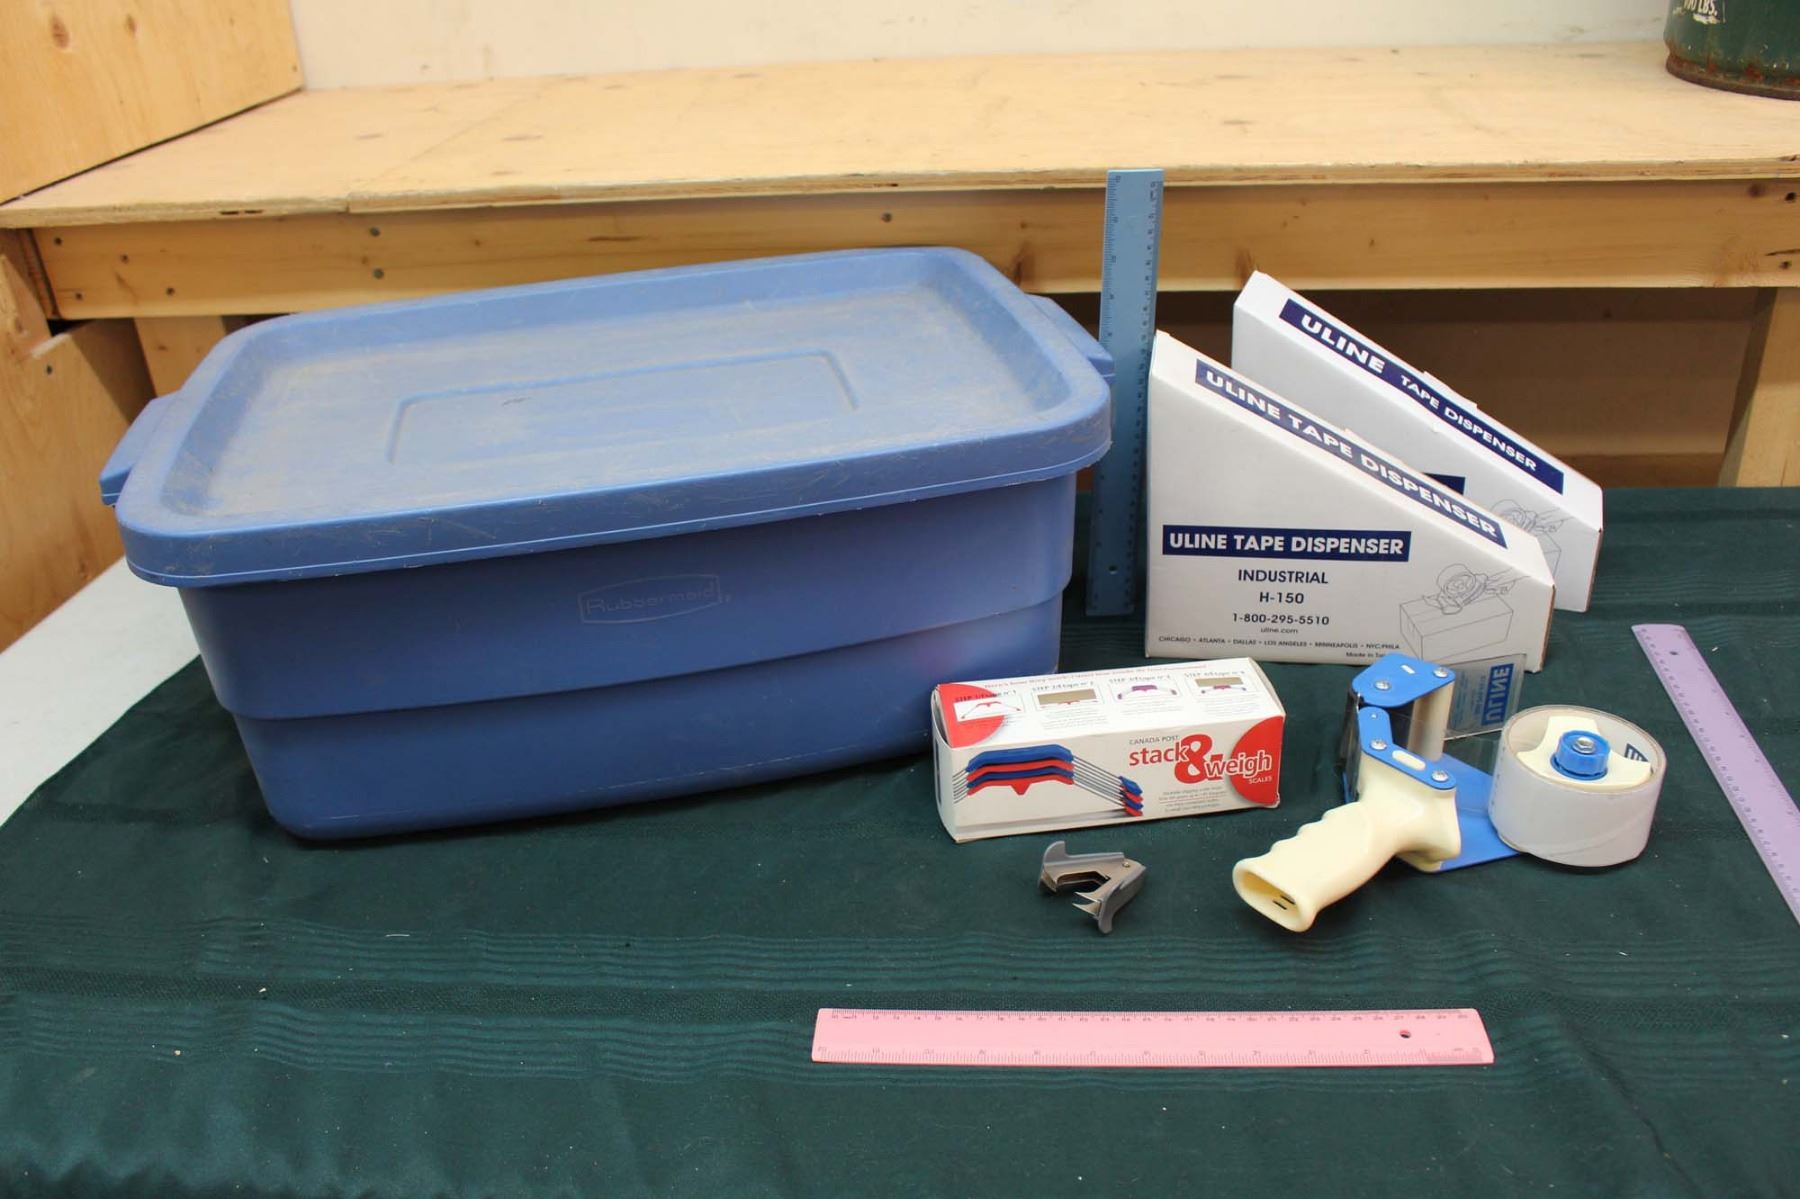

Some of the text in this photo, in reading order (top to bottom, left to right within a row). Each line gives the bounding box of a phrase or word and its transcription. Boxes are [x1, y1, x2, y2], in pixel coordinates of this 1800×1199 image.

[1301, 314, 1537, 472] ULINE TAPE DISPENSER
[1206, 371, 1498, 538] ULINE TAPE DISPENSER
[1169, 532, 1404, 555] ULINE TAPE DISPENSER
[1238, 569, 1329, 584] INDUSTRIAL
[1259, 592, 1305, 604] H-150
[1232, 613, 1330, 626] 1-800-295-5510
[1158, 635, 1191, 643] CHICAGO
[1314, 641, 1359, 649] MINNEAPOLIS
[1129, 734, 1180, 745] CANADA POST
[1129, 733, 1272, 784] stack & weigh
[1248, 776, 1273, 784] SCALES
